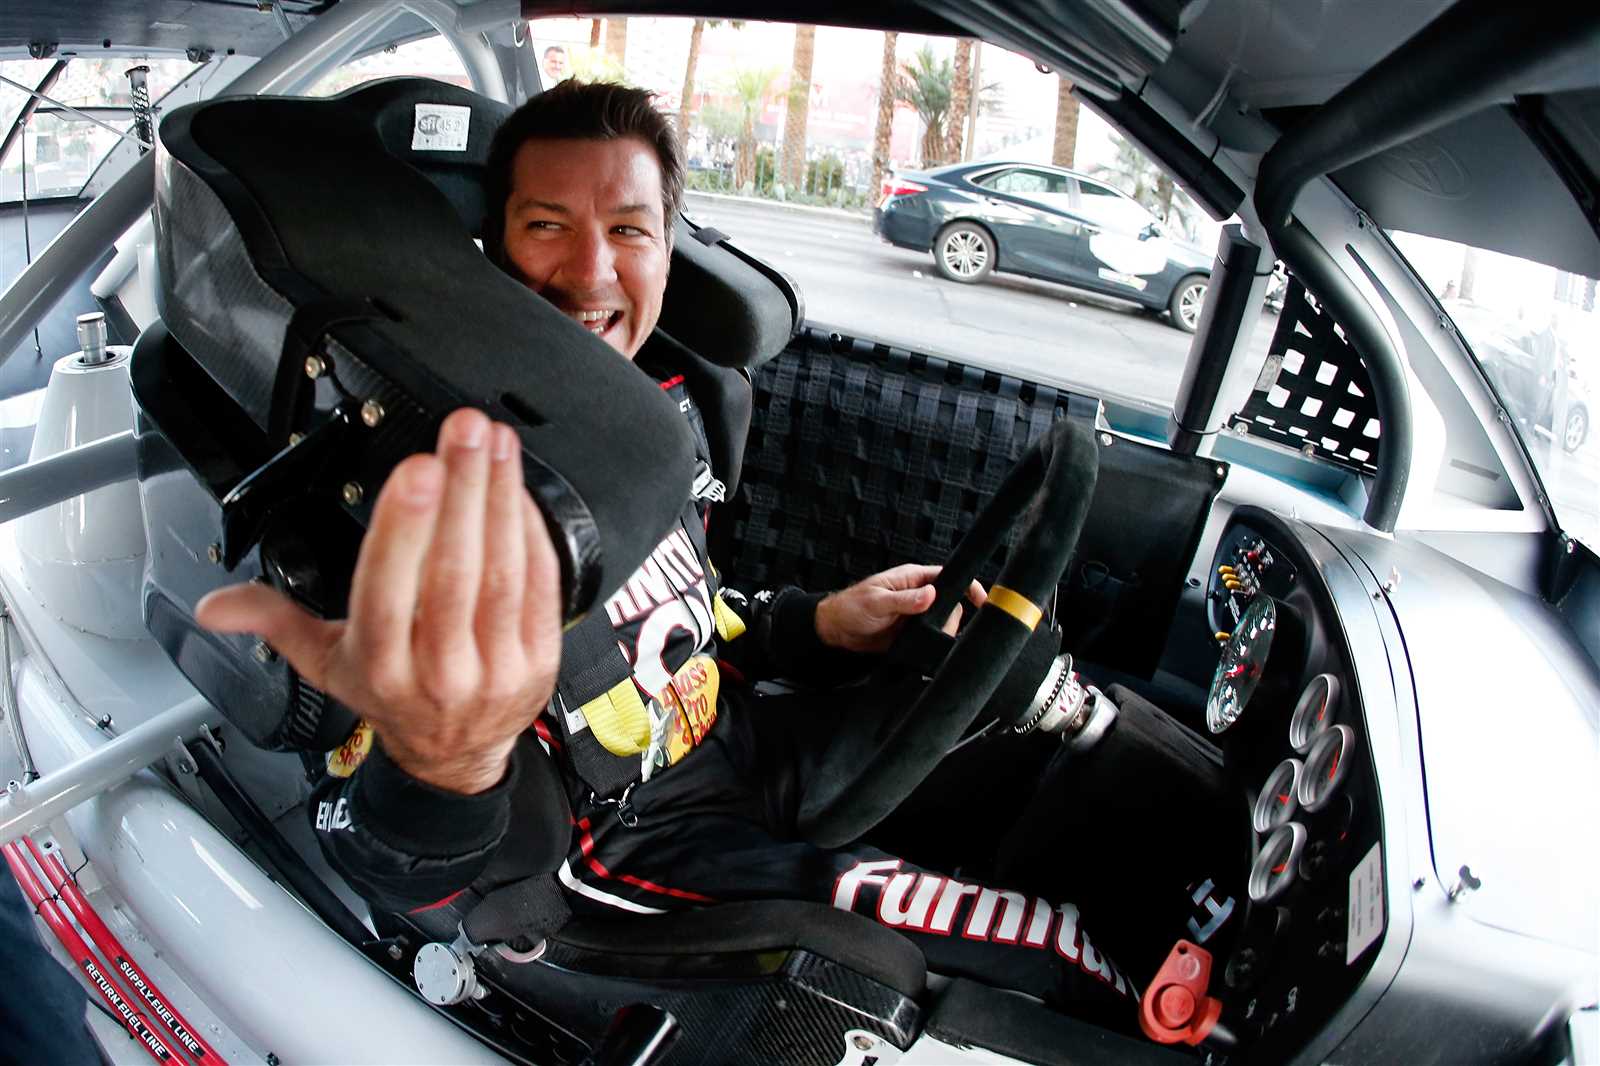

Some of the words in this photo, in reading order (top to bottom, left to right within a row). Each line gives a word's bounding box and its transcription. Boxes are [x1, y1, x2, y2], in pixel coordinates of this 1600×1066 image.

[86, 963, 120, 1005] RETURN
[117, 1002, 142, 1032] FUEL
[140, 1030, 166, 1057] LINE
[120, 961, 154, 1000] SUPPLY
[151, 998, 176, 1028] FUEL
[174, 1026, 199, 1055] LINE
